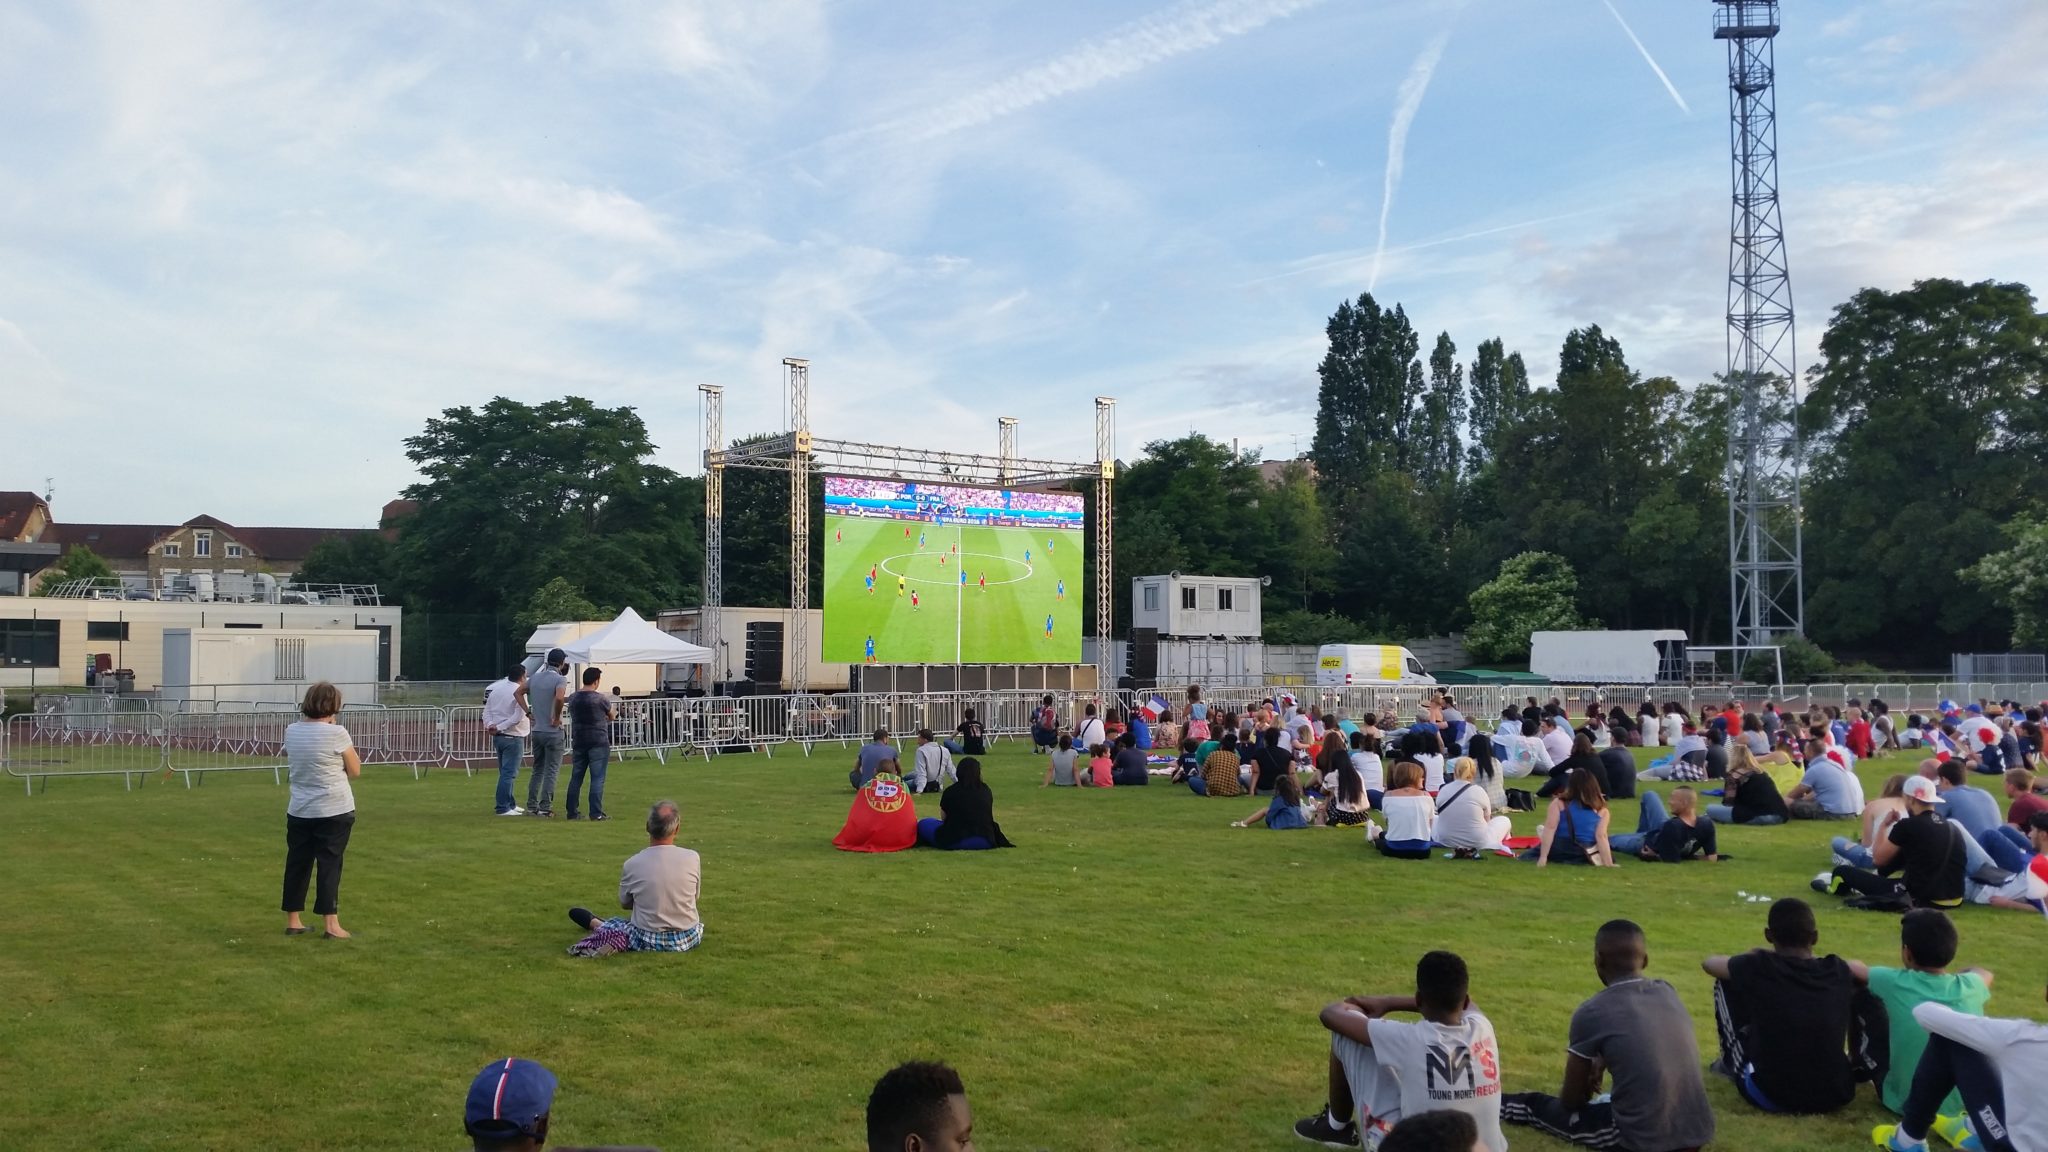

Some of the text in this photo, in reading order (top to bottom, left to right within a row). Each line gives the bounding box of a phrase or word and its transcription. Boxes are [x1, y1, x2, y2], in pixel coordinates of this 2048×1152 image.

[1321, 659, 1340, 667] Hertz
[1428, 1088, 1476, 1101] YOUNG MONEY
